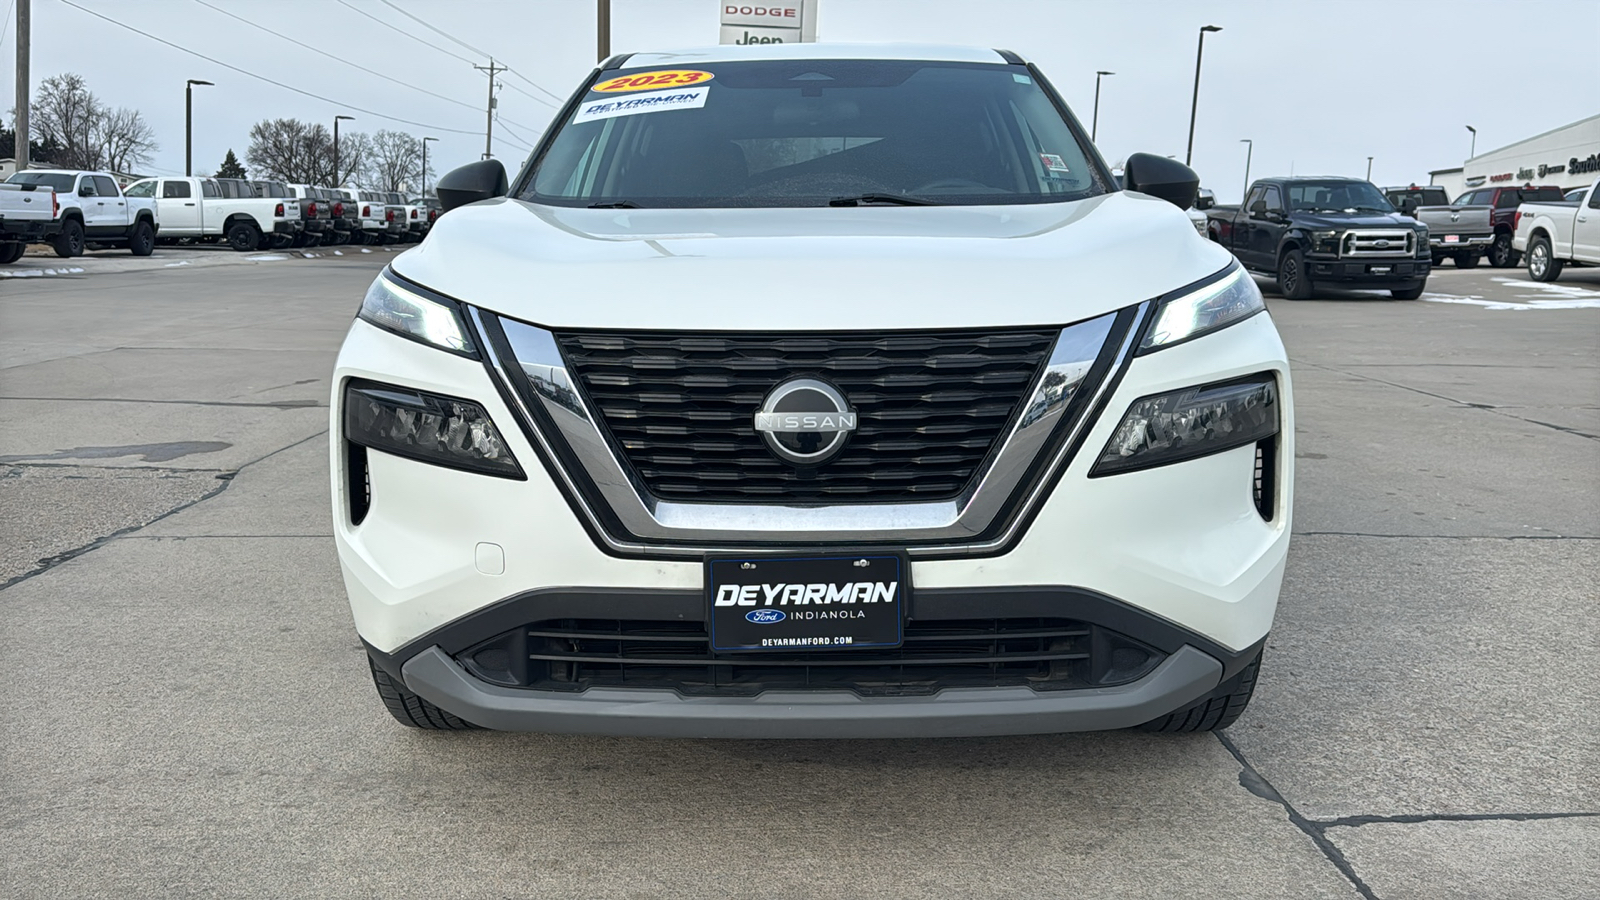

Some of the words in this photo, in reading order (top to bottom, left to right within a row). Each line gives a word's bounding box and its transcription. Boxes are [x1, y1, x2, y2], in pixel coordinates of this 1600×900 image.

[725, 5, 796, 18] DODGE
[602, 72, 703, 91] 2023
[585, 92, 701, 114] DEYARMAN
[592, 103, 639, 115] CERTIFIED
[758, 415, 853, 428] NISSAN
[714, 581, 898, 607] DEYARMAN
[753, 610, 778, 622] Ford
[790, 610, 866, 620] INDIANOLA
[762, 636, 853, 646] DEYARMANFORD.COM
